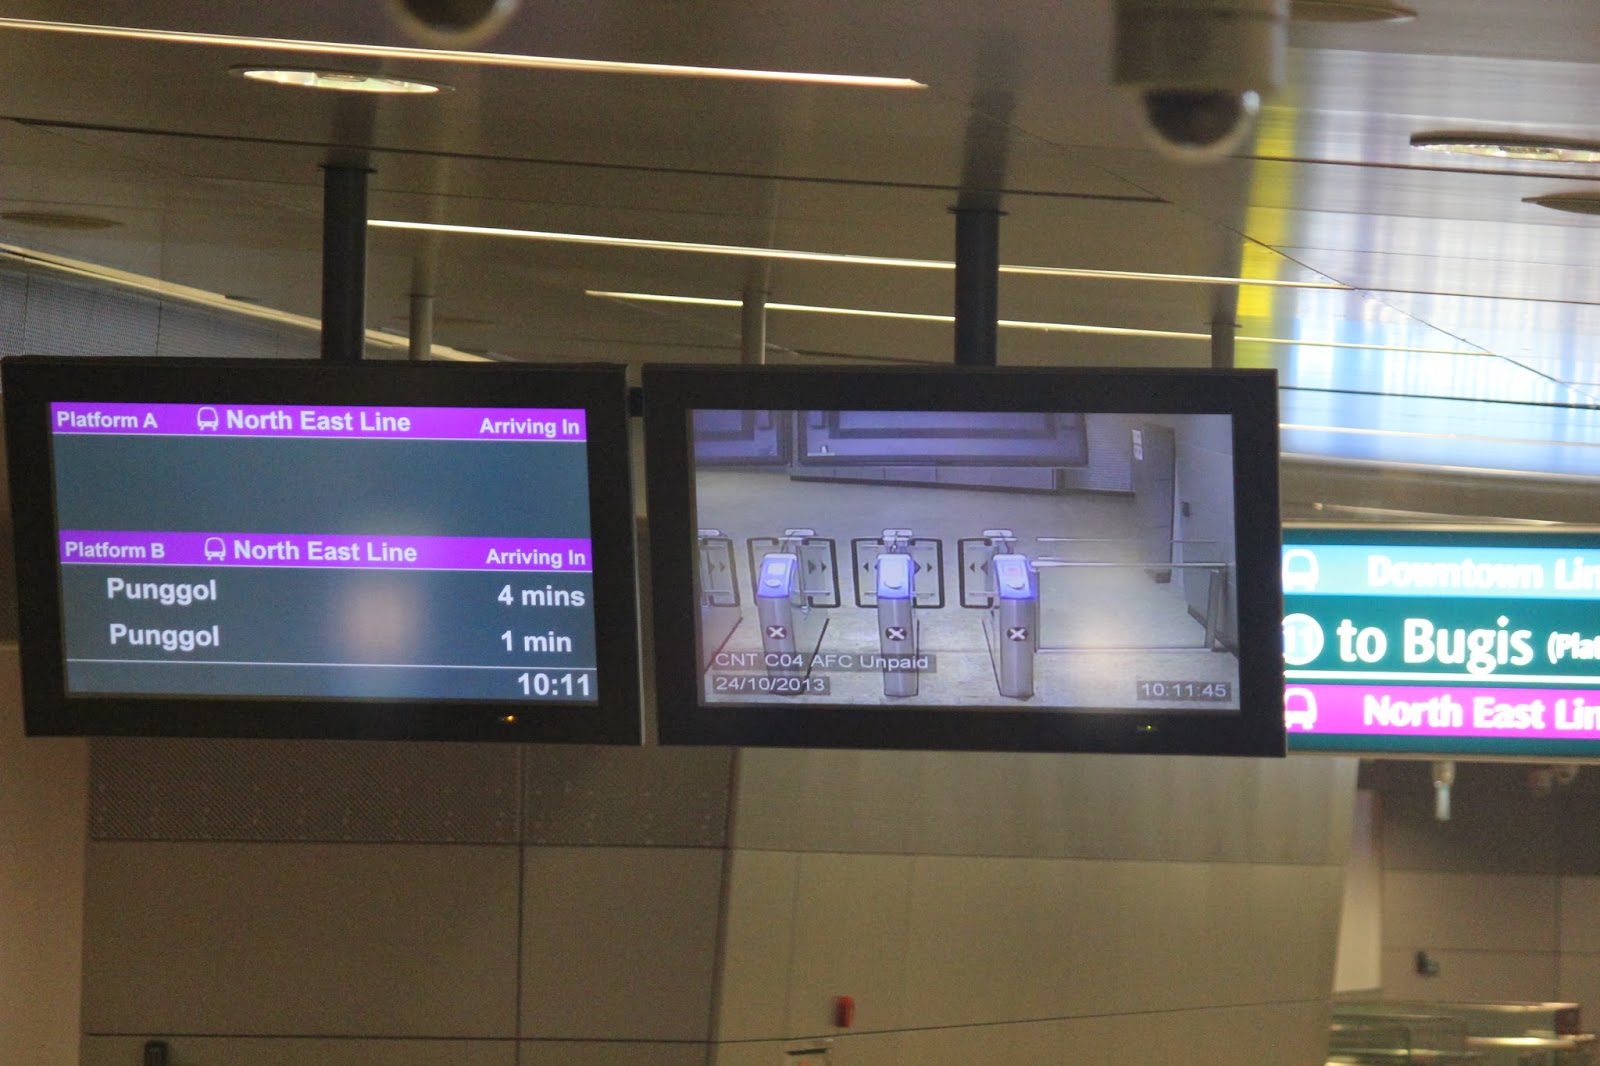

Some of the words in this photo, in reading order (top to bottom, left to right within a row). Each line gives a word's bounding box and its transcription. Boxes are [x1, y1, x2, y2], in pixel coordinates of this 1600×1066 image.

[57, 411, 138, 428] Platform
[143, 413, 158, 428] A
[227, 410, 293, 429] North
[301, 411, 353, 431] East
[360, 412, 411, 432] Line
[480, 418, 556, 438] Arriving
[562, 419, 580, 435] In
[65, 542, 146, 558] Platform
[151, 543, 165, 559] B
[234, 540, 299, 560] North
[308, 541, 360, 561] East
[367, 542, 418, 562] Line
[486, 549, 563, 569] Arriving
[569, 550, 586, 566] In
[1367, 555, 1543, 588] Downtown
[107, 577, 217, 605] Punggol
[498, 585, 514, 606] 4
[521, 585, 586, 606] mins
[109, 623, 220, 651] Punggol
[501, 630, 513, 652] 1
[524, 631, 572, 653] min
[1336, 618, 1387, 663] to
[1403, 615, 1534, 675] Bugis
[715, 653, 757, 667] CNT
[765, 654, 803, 668] C04
[811, 655, 853, 668] AFC
[860, 655, 929, 672] Unpaid
[518, 673, 590, 696] 10:11
[715, 677, 825, 692] 24/10/2013
[1142, 683, 1227, 697] 10:11:45
[1363, 694, 1463, 727] North
[1473, 697, 1546, 730] East
